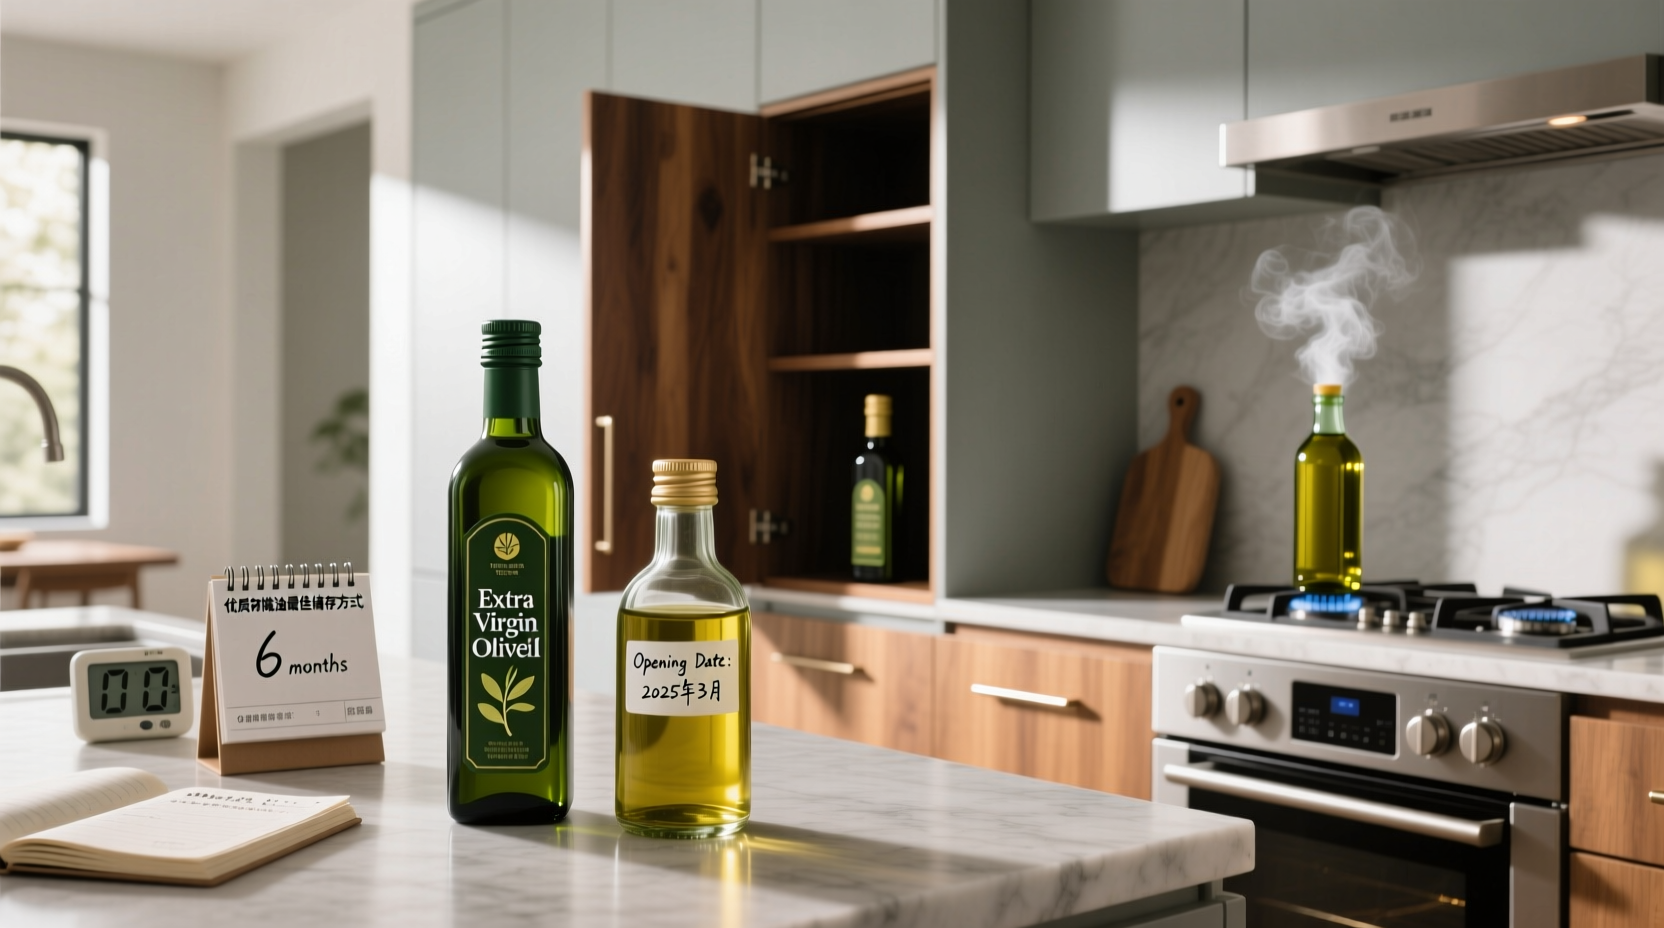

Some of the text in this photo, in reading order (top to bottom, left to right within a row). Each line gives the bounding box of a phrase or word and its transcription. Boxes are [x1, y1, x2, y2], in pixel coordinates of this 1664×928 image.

[477, 588, 535, 609] Extra
[472, 612, 539, 638] Virgin
[255, 629, 348, 679] 6 months
[633, 652, 731, 676] Opening Date:
[641, 678, 721, 706] 2025年3月
